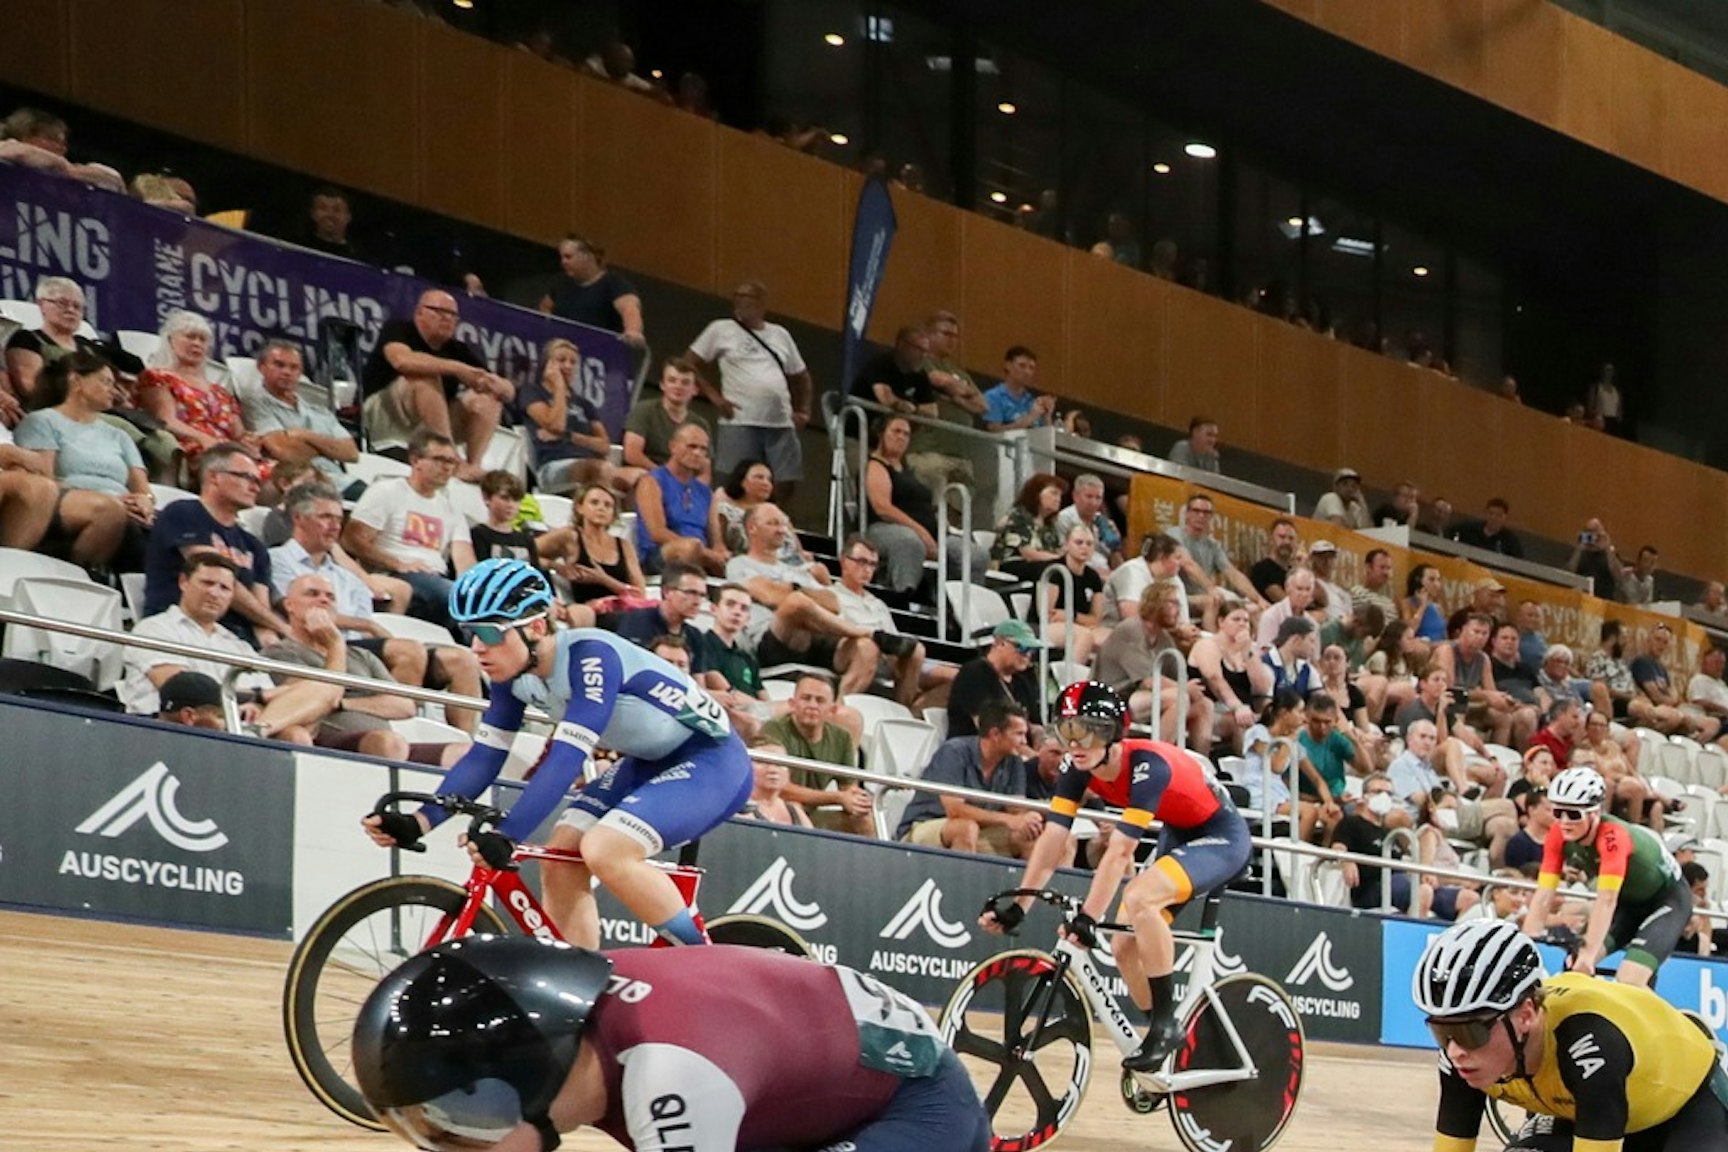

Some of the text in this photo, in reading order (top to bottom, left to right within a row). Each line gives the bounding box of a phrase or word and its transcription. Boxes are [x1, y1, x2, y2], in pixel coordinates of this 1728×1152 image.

[0, 201, 111, 280] ING
[580, 657, 604, 704] NSW
[648, 681, 687, 712] LAZE
[1132, 762, 1150, 785] SA
[1604, 829, 1618, 852] TAS
[59, 850, 245, 896] AUSCYCLING
[1567, 1033, 1606, 1080] WA
